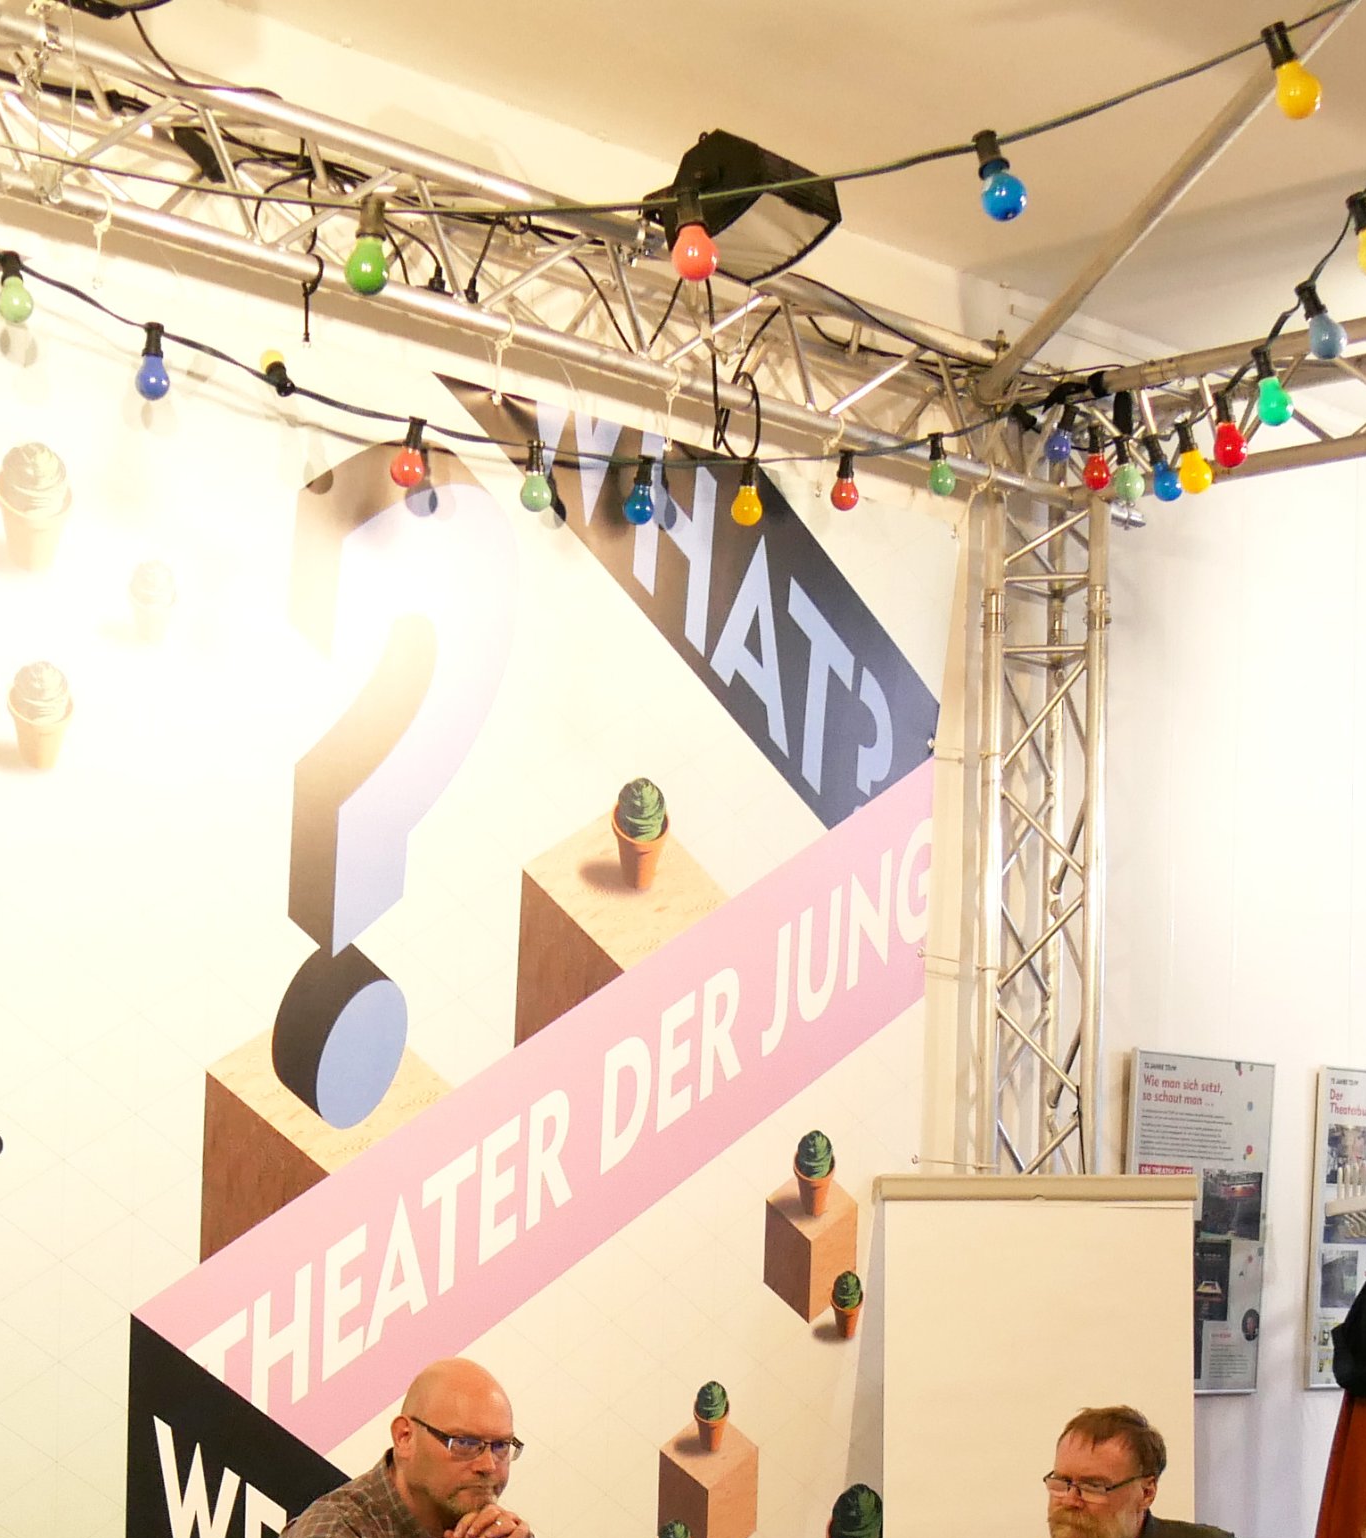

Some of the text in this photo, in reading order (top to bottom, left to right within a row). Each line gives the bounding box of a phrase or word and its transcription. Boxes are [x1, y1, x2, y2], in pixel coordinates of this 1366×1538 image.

[1143, 1073, 1159, 1087] Wie
[1162, 1079, 1180, 1089] man
[1183, 1077, 1199, 1090] sich
[1184, 1095, 1202, 1105] man
[186, 1089, 571, 1417] THEATER
[599, 966, 741, 1174] DER
